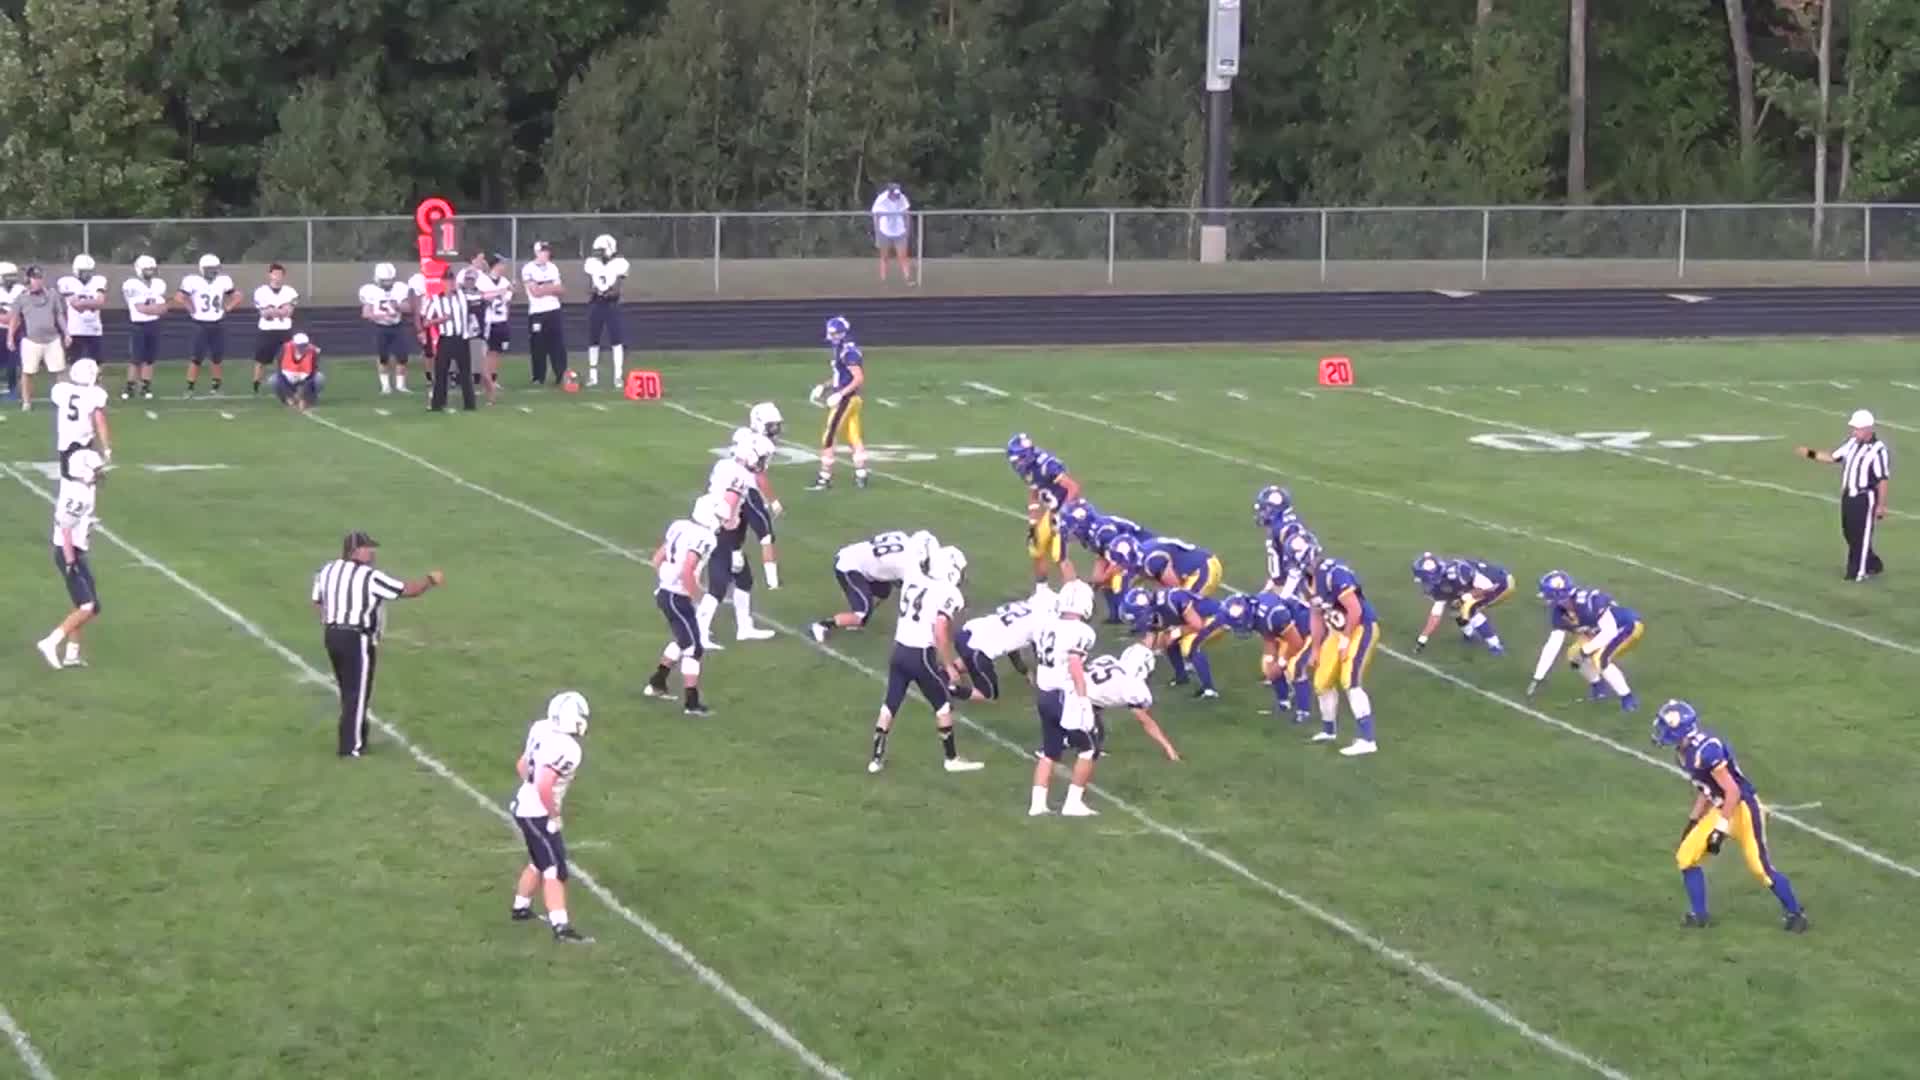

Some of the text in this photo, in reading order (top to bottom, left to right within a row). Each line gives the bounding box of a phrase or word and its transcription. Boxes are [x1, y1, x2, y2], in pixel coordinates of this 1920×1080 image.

[440, 222, 455, 251] 1
[200, 294, 223, 314] 34
[1325, 361, 1350, 384] 20
[633, 375, 657, 398] 30
[67, 393, 81, 422] 5
[872, 535, 905, 558] 58
[900, 584, 929, 622] 54
[1038, 631, 1057, 669] 12
